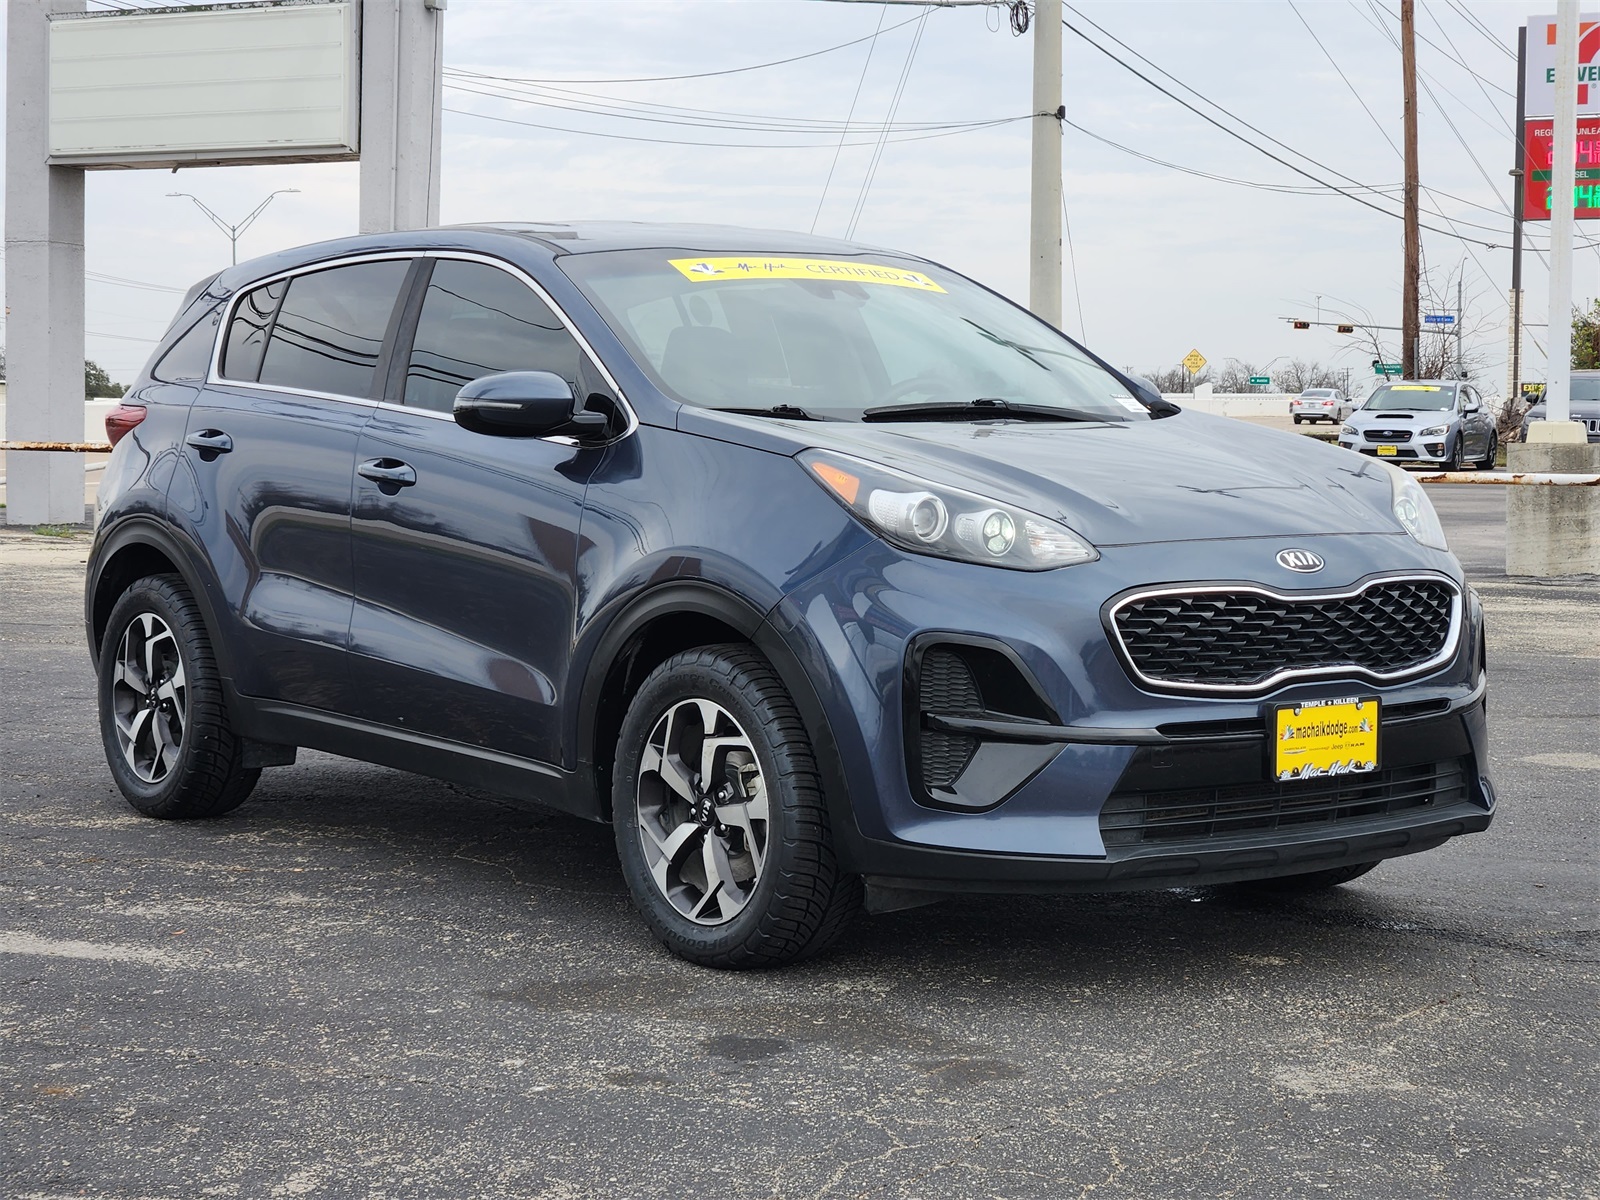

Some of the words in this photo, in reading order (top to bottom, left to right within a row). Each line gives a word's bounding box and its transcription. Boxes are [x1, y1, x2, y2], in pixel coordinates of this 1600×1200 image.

[1546, 66, 1600, 83] EVE
[1576, 127, 1600, 136] UNLEA
[805, 264, 900, 281] CERTIFIED
[1282, 551, 1321, 567] KIA
[1300, 699, 1326, 709] TEMPLE
[1333, 697, 1359, 706] KILLEEN
[1295, 720, 1359, 739] machaikdodge.com
[701, 800, 711, 822] KIA
